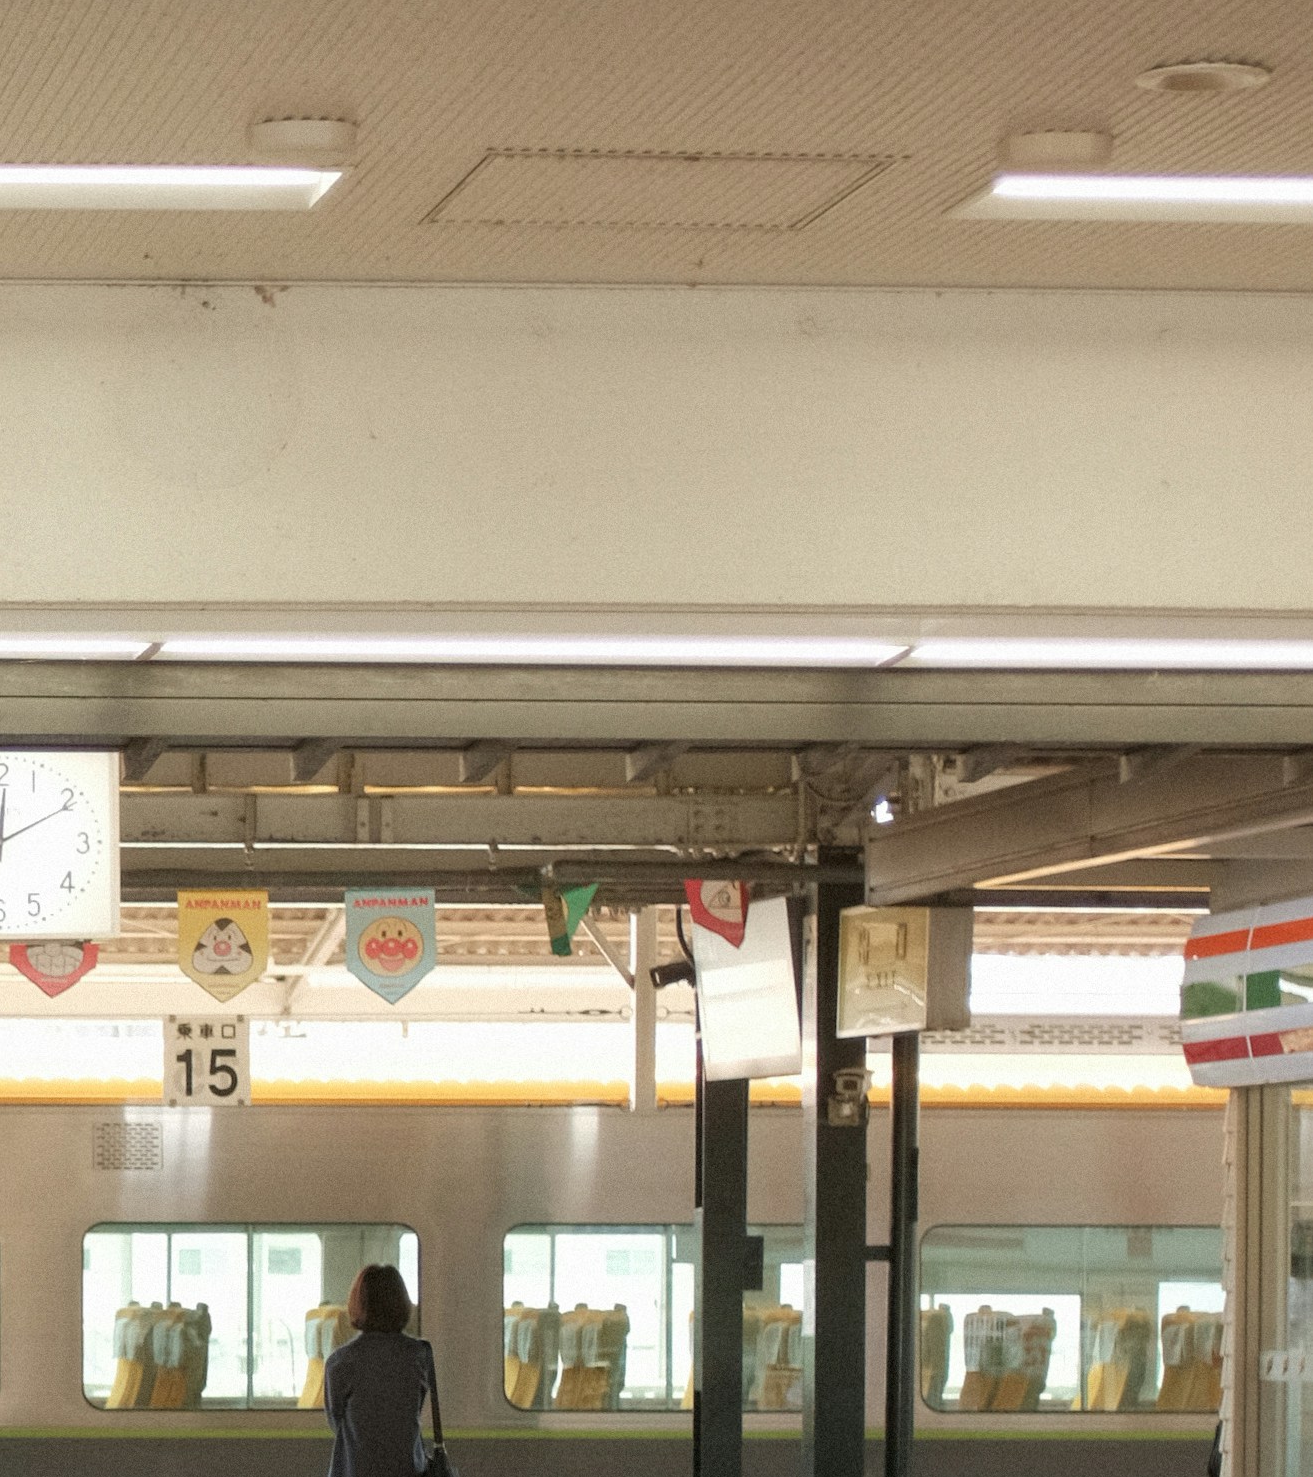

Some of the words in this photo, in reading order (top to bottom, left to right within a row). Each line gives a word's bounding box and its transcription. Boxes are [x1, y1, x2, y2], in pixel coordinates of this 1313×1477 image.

[60, 787, 74, 812] 2
[76, 831, 90, 854] 3
[59, 870, 75, 894] 4
[27, 892, 40, 917] 5
[184, 898, 261, 911] ANPANMAN
[352, 896, 429, 910] ANPANMAN
[176, 1023, 237, 1041] 乗車口
[176, 1048, 238, 1098] 15
